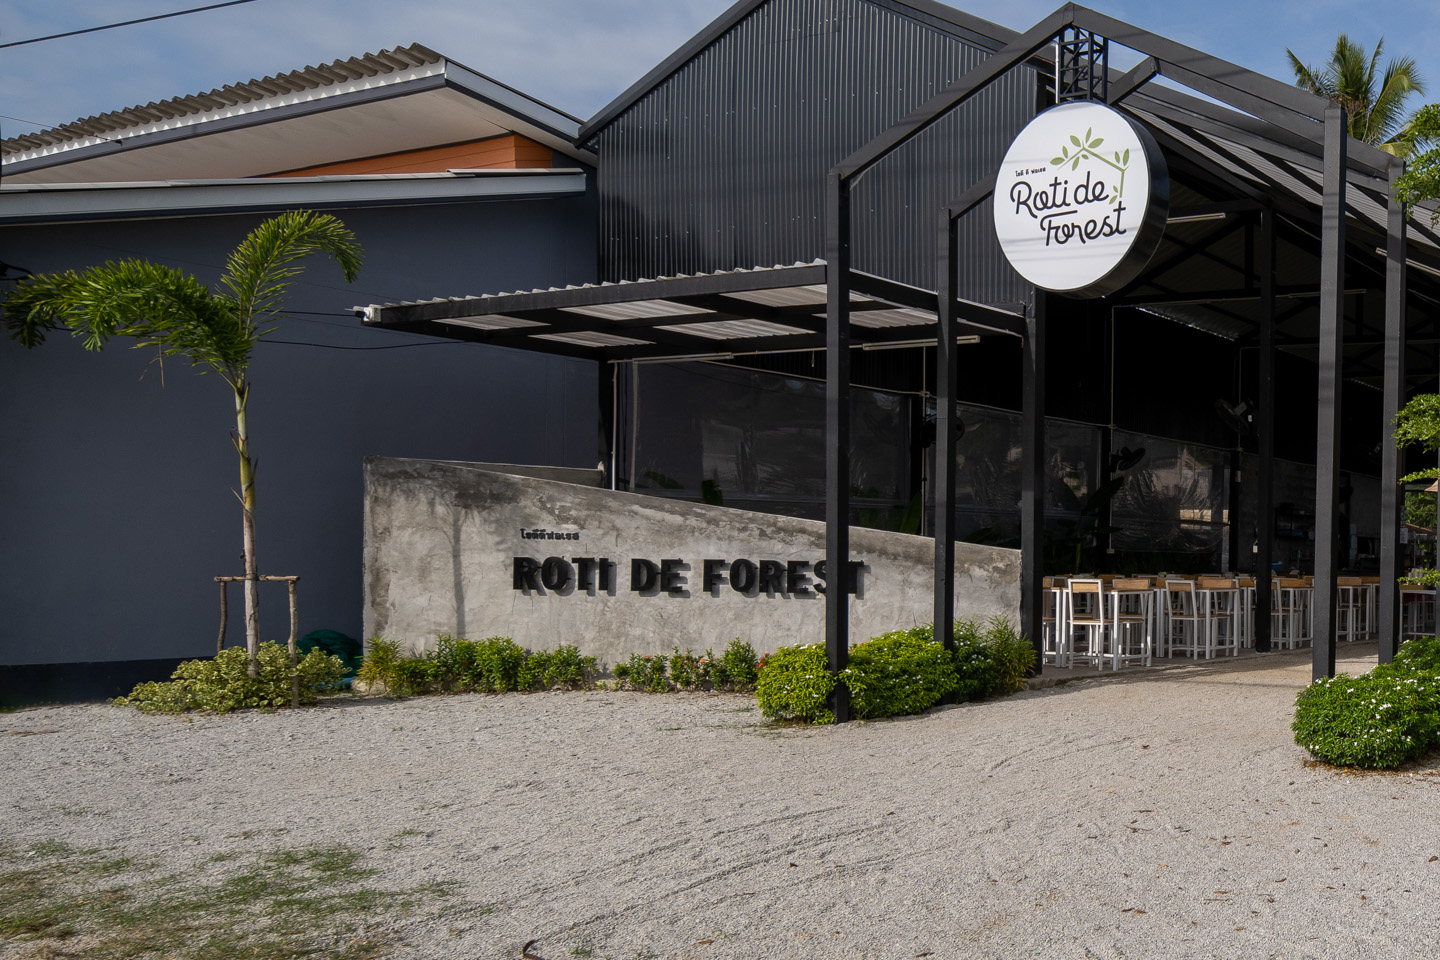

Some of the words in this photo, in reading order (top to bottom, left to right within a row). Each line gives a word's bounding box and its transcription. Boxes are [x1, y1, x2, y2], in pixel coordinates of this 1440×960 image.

[1010, 176, 1071, 219] Roti
[1073, 170, 1110, 205] de
[1039, 200, 1127, 246] Forest
[513, 556, 610, 591] ROTI
[631, 558, 683, 592] DE
[703, 559, 865, 594] FOREST
